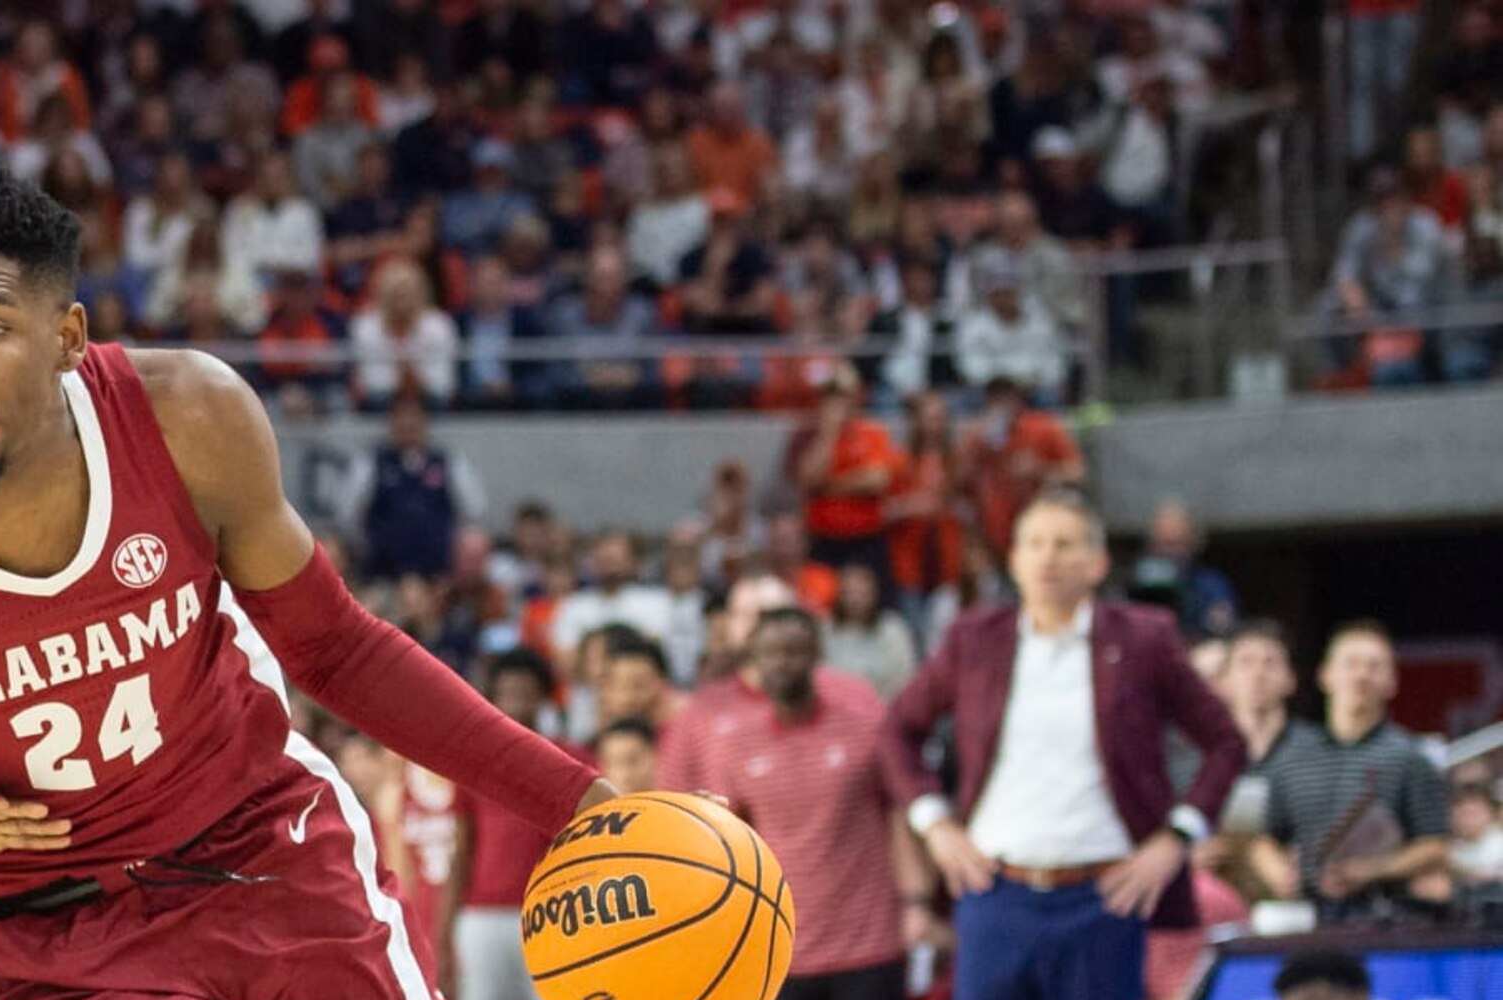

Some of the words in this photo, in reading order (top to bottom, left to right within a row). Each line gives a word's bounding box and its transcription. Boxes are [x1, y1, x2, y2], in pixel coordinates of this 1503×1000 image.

[116, 538, 164, 584] SEC
[10, 673, 163, 791] 24
[521, 874, 656, 945] Wilson
